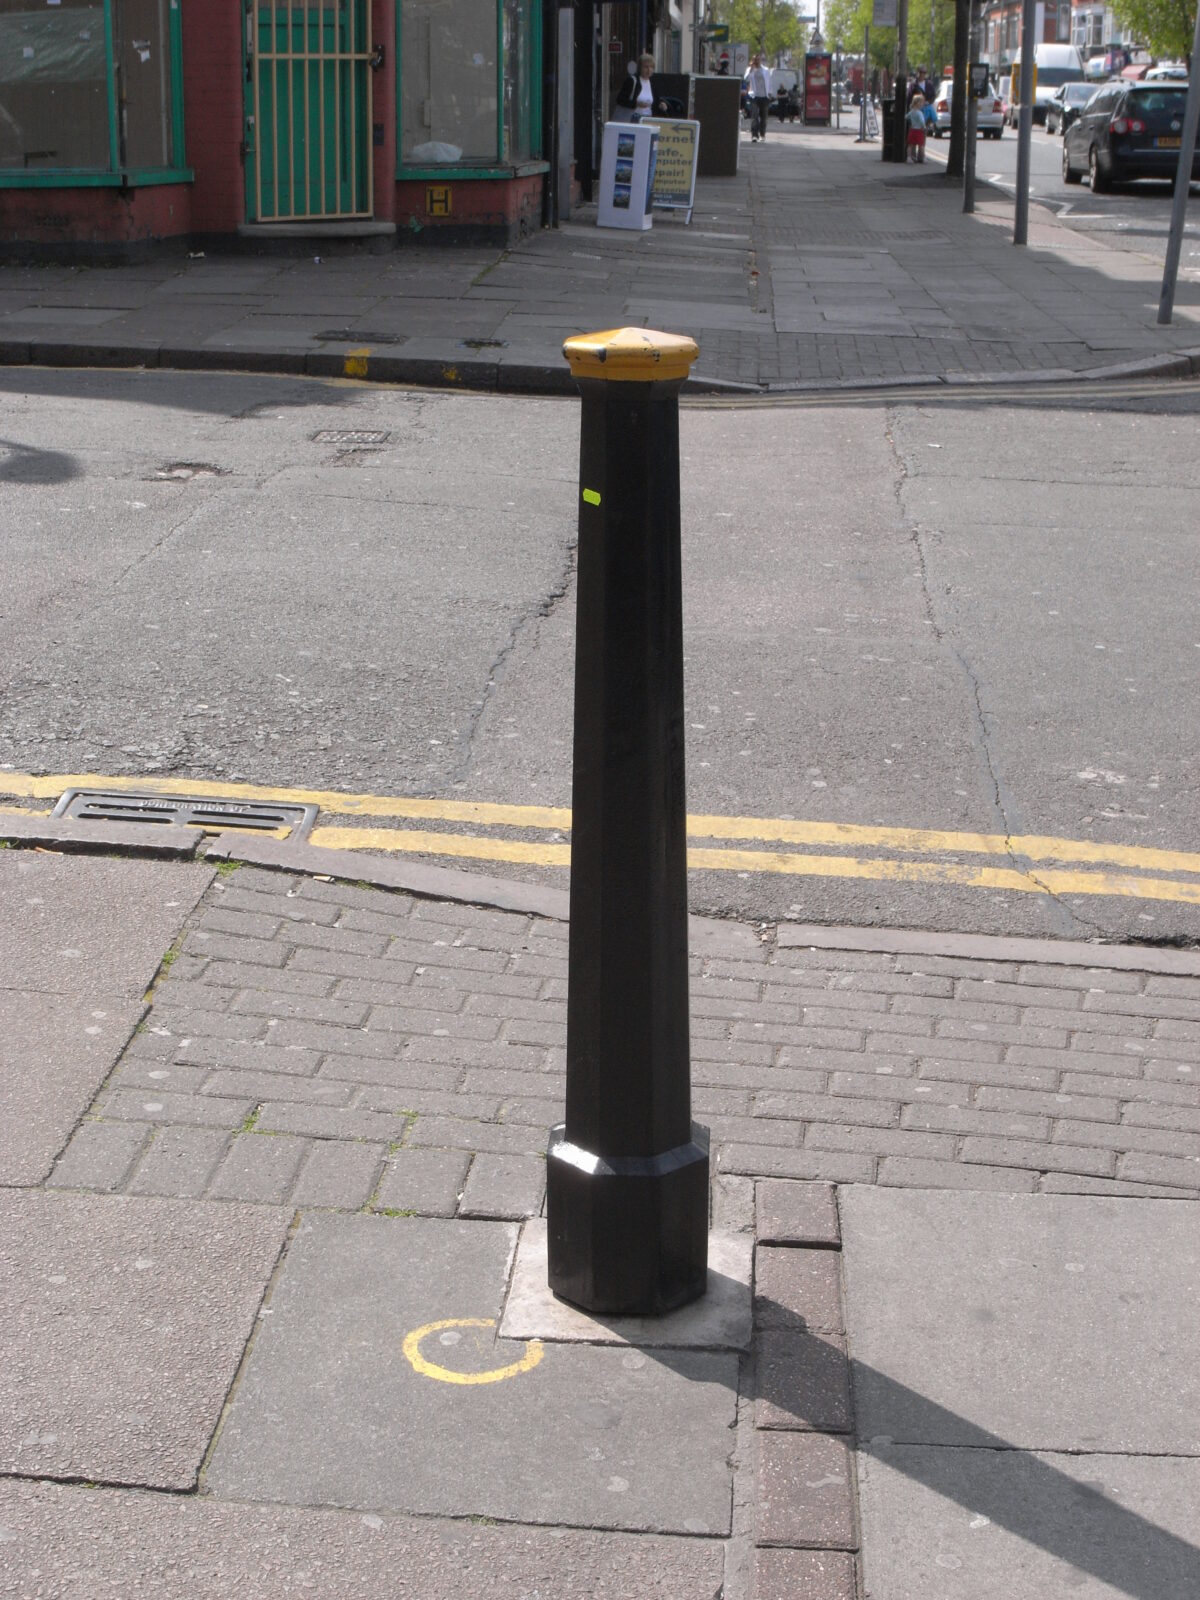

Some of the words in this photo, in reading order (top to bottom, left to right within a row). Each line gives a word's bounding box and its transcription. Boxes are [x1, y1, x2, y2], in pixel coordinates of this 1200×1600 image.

[658, 134, 696, 144] ernet
[657, 147, 684, 157] afe.
[655, 168, 685, 177] pair!
[430, 190, 449, 214] H
